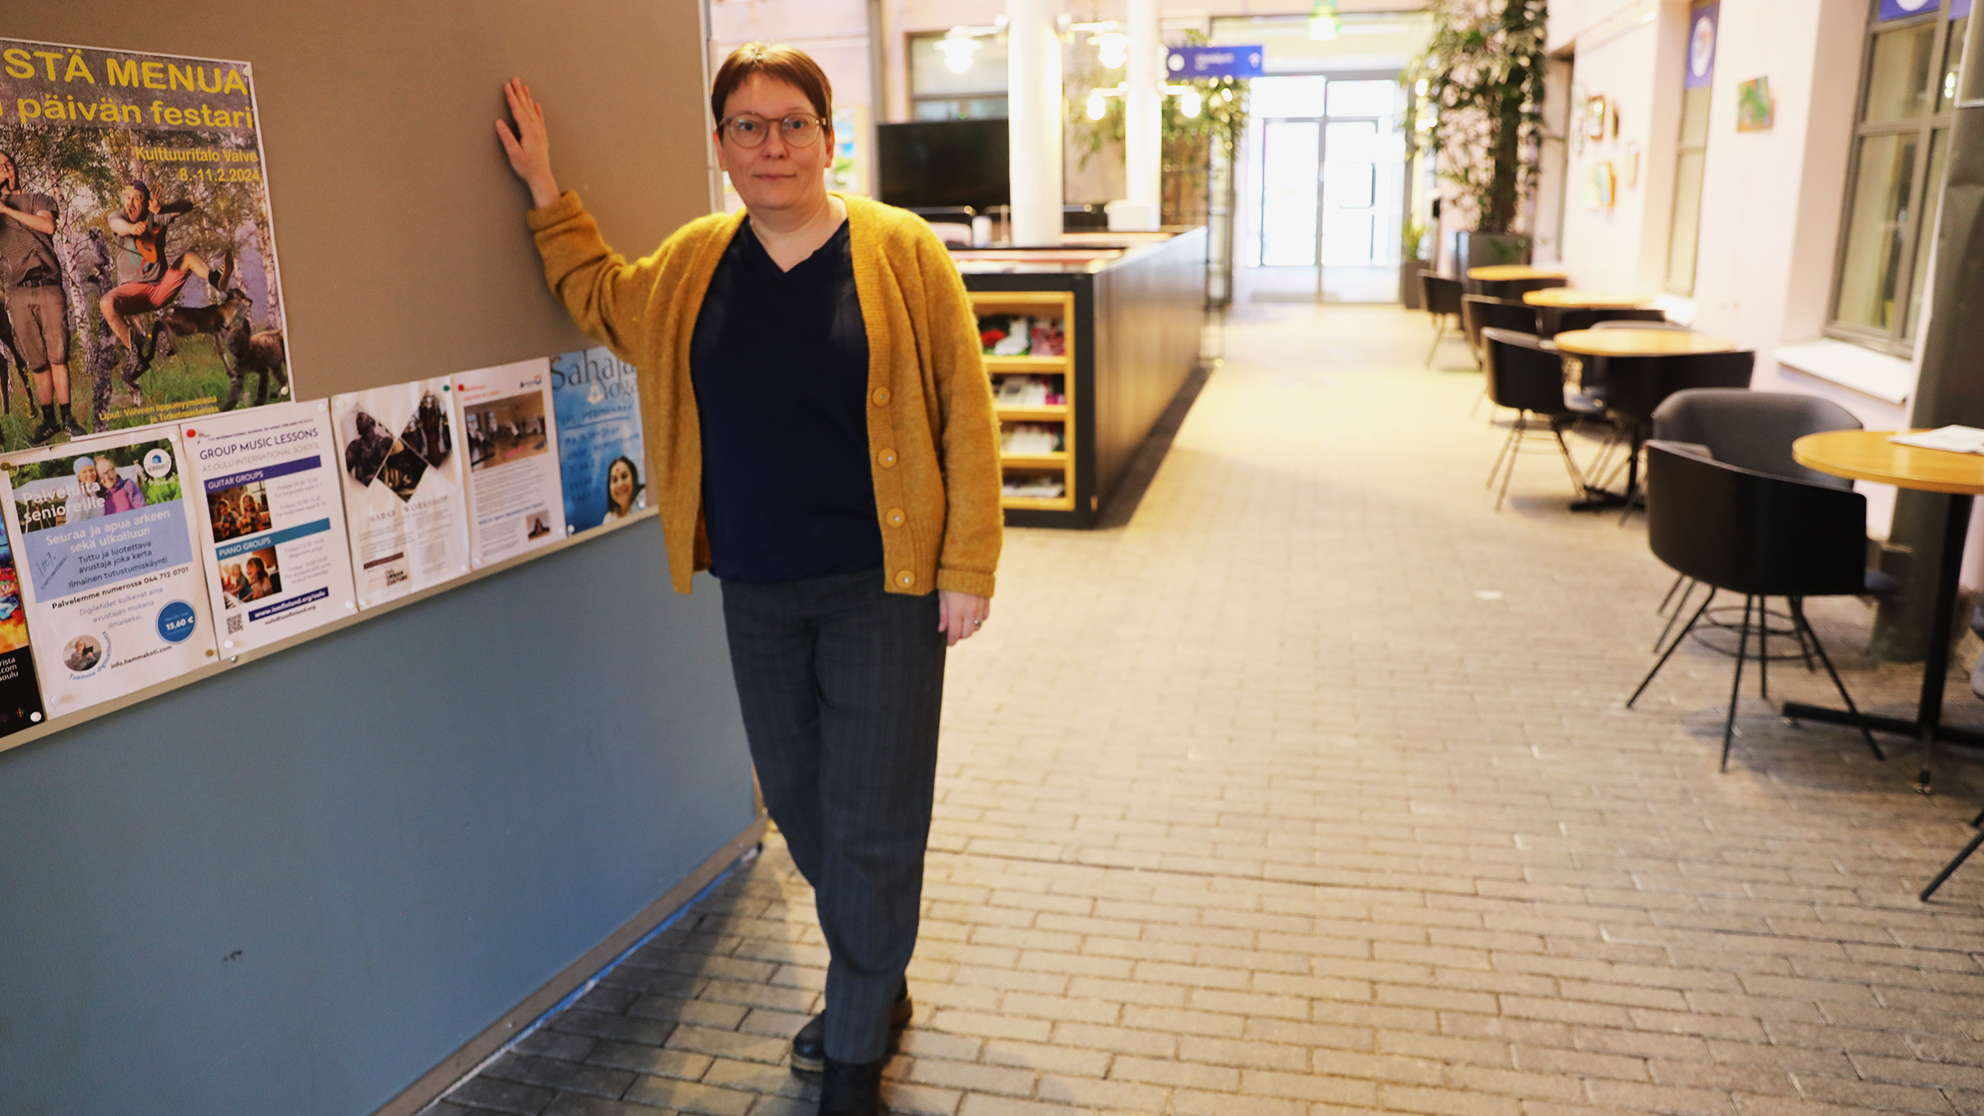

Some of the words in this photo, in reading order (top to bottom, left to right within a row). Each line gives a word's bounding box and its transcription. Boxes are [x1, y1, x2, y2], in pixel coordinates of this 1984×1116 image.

[3, 48, 95, 85] STÄ
[106, 58, 248, 95] MENUA
[17, 94, 142, 124] päivän
[150, 100, 253, 128] festari
[134, 146, 220, 162] Kulttuuritalo
[222, 148, 258, 162] Valve
[179, 168, 260, 182] 8.-11.2.2024
[124, 406, 155, 417] Valveen
[199, 444, 237, 460] GROUP
[240, 437, 273, 452] MUSIC
[274, 428, 319, 445] LESSONS
[202, 464, 211, 473] AT
[213, 460, 234, 470] OULU
[235, 449, 291, 467] INTERNATIONAL
[294, 442, 320, 454] SCHOOL
[208, 476, 234, 489] GUITAR
[235, 470, 264, 484] GROUPS
[23, 481, 101, 506] Palveluita
[24, 496, 106, 523] senioreille
[45, 529, 86, 546] Seuraa
[90, 524, 101, 537] ja
[104, 520, 131, 535] apua
[134, 509, 171, 525] arkeen
[70, 538, 96, 553] sekä
[100, 526, 151, 547] ulkoiluun
[78, 553, 100, 564] Tuttu
[101, 549, 110, 559] ja
[111, 540, 152, 556] luotettava
[219, 543, 242, 557] PIANO
[243, 536, 271, 551] GROUPS
[68, 575, 103, 589] Ilmainen
[104, 556, 168, 580] tutustumiskäynti
[79, 561, 112, 574] avustaja
[113, 556, 131, 568] joka
[132, 550, 152, 561] kerta
[52, 592, 100, 610] Palvelemme
[102, 580, 142, 596] numerossa
[144, 575, 158, 585] 044
[159, 571, 171, 581] 712
[172, 566, 189, 577] 0701
[149, 586, 163, 596] aina
[187, 615, 195, 624] €
[110, 645, 173, 669] info.hemmakoti.com
